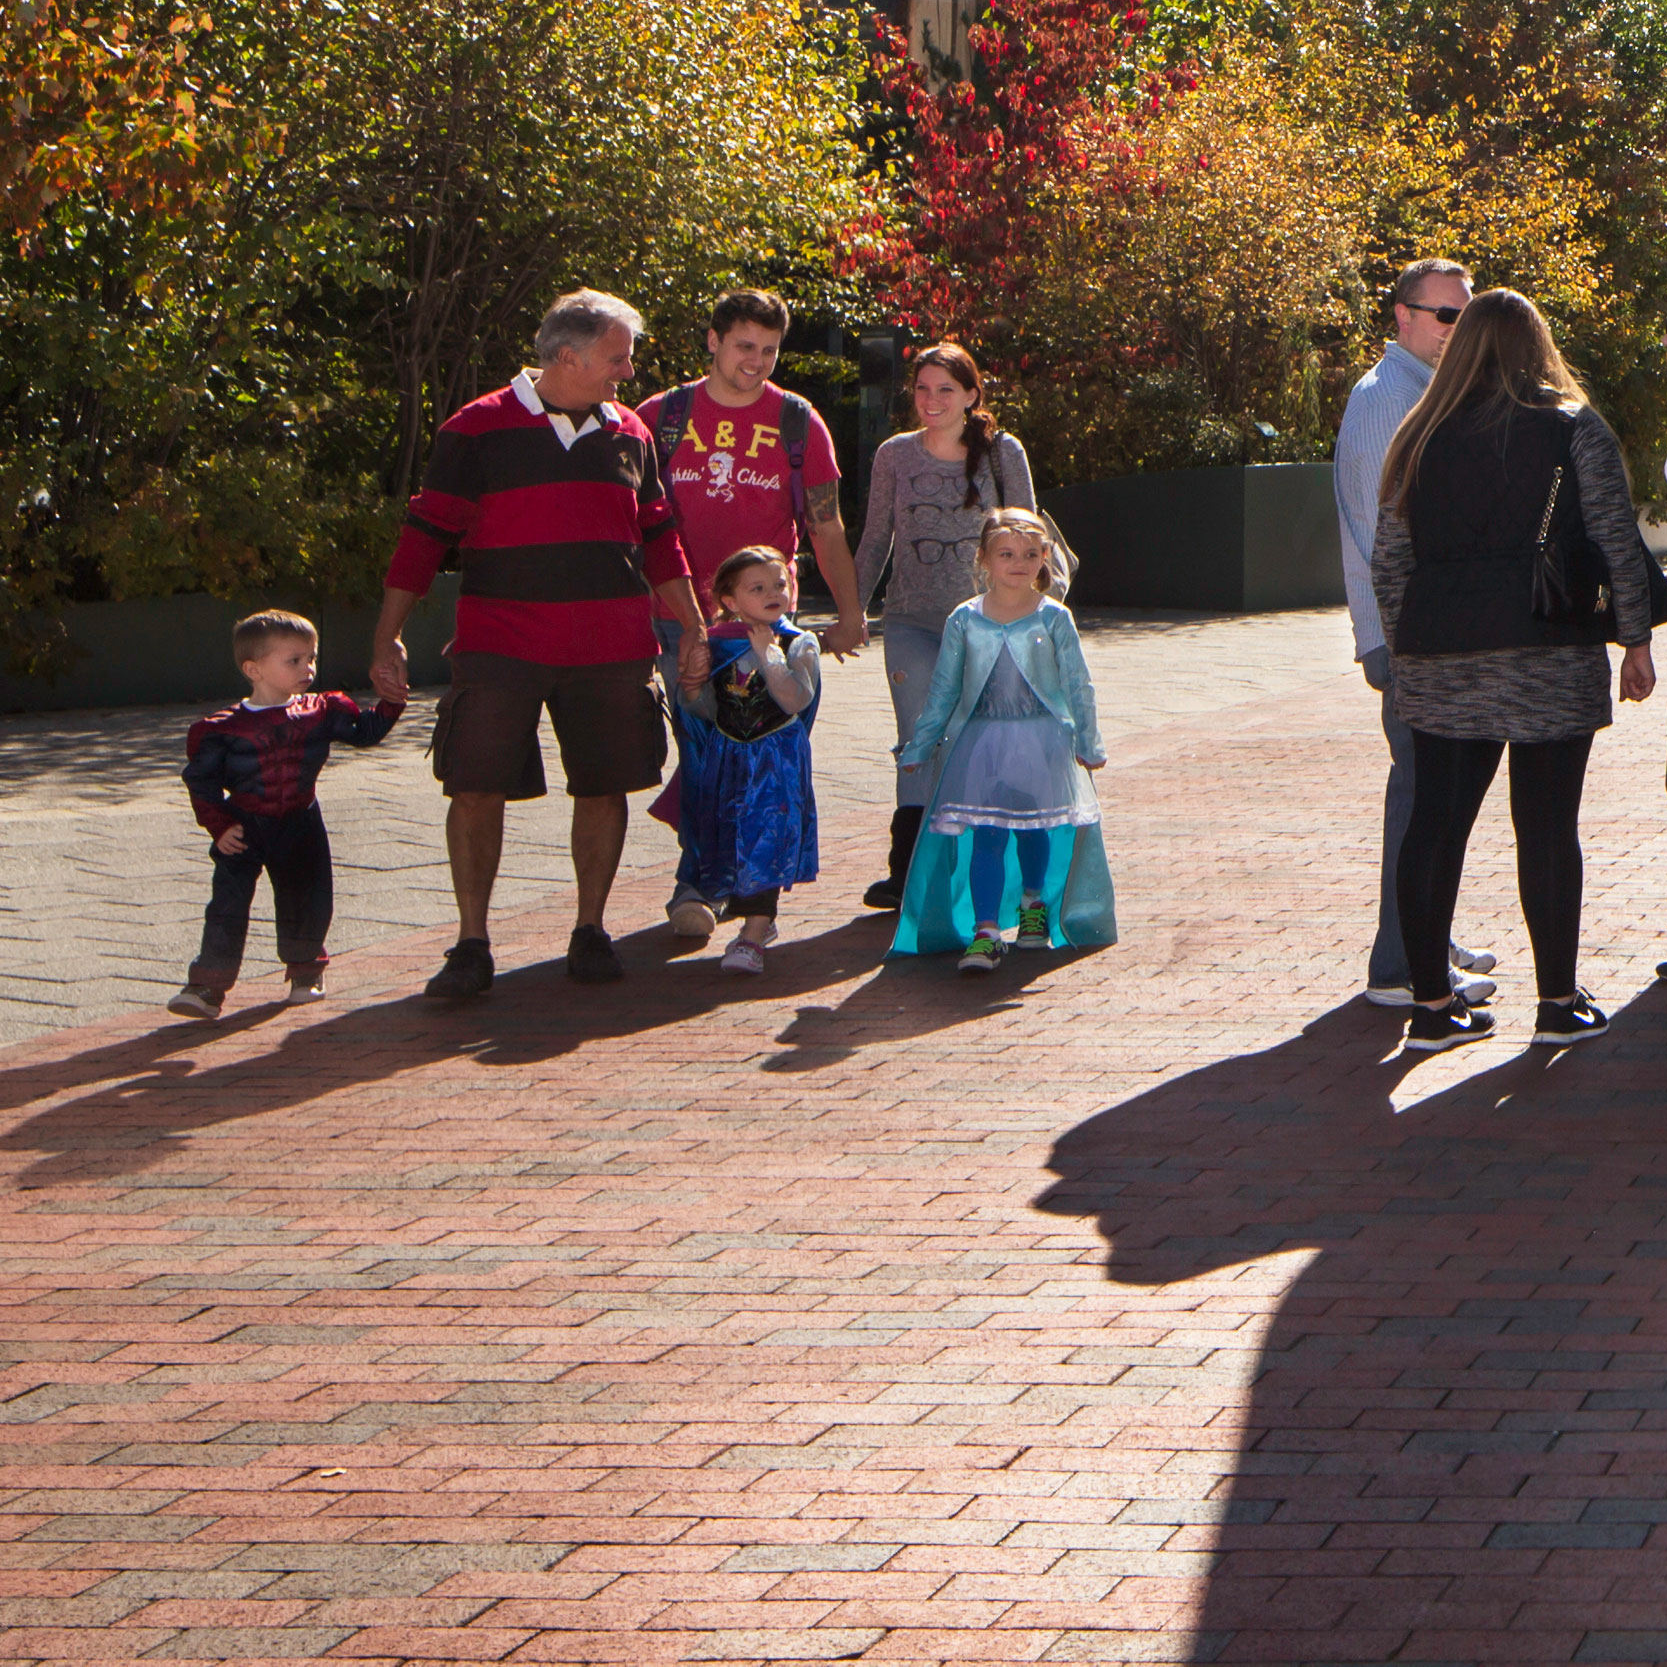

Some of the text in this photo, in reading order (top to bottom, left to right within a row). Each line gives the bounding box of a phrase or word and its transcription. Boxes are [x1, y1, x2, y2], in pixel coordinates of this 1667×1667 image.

[682, 418, 781, 458] A & F
[737, 468, 781, 490] Chiefs
